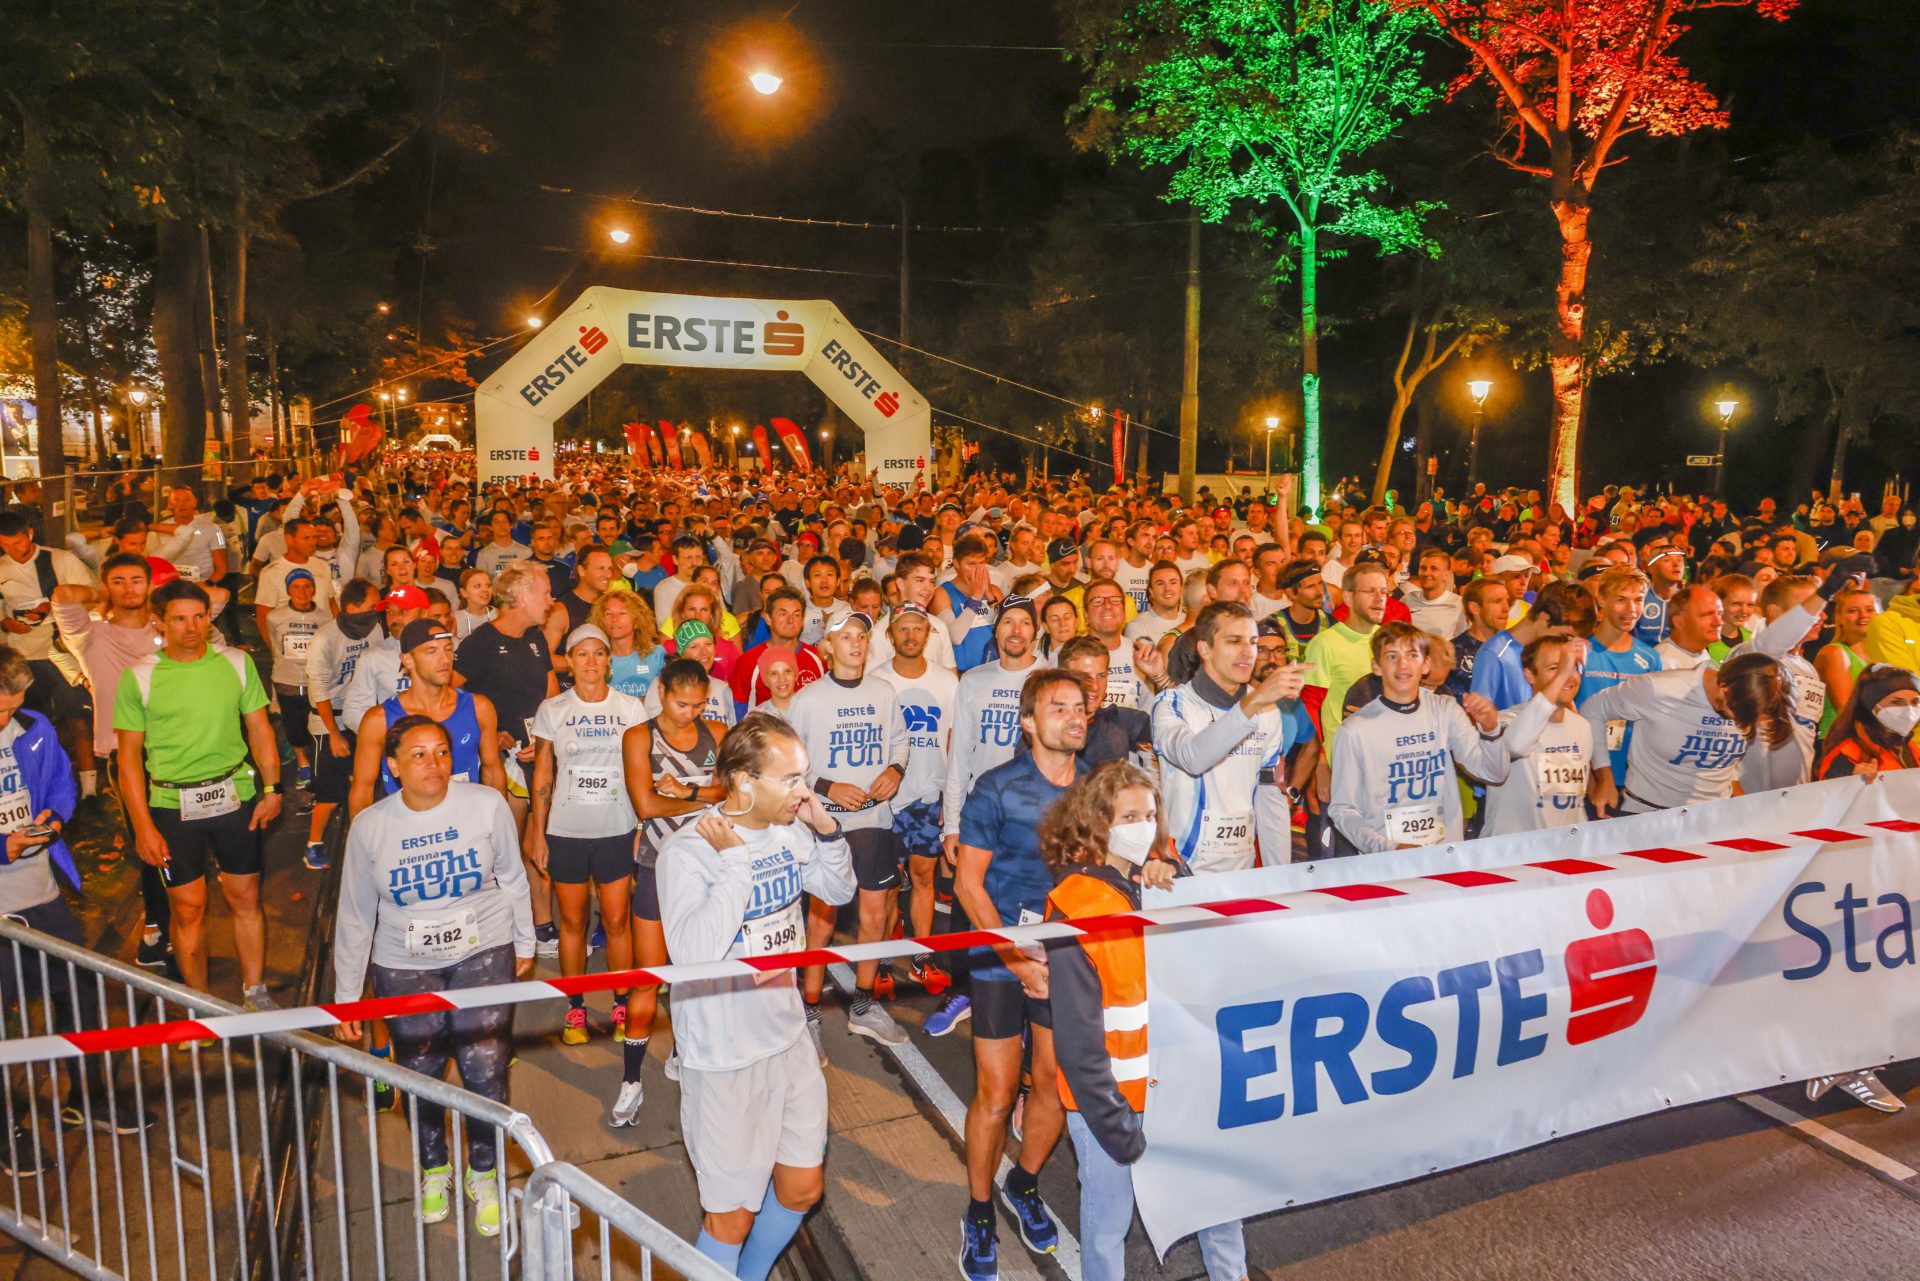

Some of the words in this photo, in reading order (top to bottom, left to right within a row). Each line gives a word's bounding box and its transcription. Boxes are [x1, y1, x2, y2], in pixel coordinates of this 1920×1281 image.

[628, 312, 754, 354] ERSTE
[520, 345, 588, 407] ERSTE
[821, 339, 882, 399] ERSTE
[490, 450, 526, 460] ERSTE
[884, 459, 915, 469] ERSTE
[992, 689, 1020, 699] ERSTE
[838, 706, 866, 717] ERSTE
[566, 715, 627, 726] JABIL
[836, 721, 863, 729] vienna
[1702, 716, 1734, 727] ERSTE
[575, 728, 619, 738] VIENNA
[829, 722, 883, 750] night
[1396, 733, 1427, 747] ERSTE
[1682, 733, 1746, 757] nigh
[827, 742, 883, 768] run
[1395, 750, 1425, 760] vienna
[578, 777, 608, 788] 2962
[1544, 768, 1583, 784] 11344
[195, 787, 226, 804] 3002
[0, 803, 31, 826] 3101
[1216, 824, 1247, 839] 2740
[1401, 816, 1436, 833] 2922
[401, 832, 443, 850] ERSTE
[388, 847, 482, 886] night
[399, 851, 440, 865] vienna
[389, 870, 483, 907] run
[746, 863, 801, 910] nigh
[423, 927, 463, 946] 2182
[763, 924, 797, 952] 3498
[1215, 947, 1549, 1130] ERSTE
